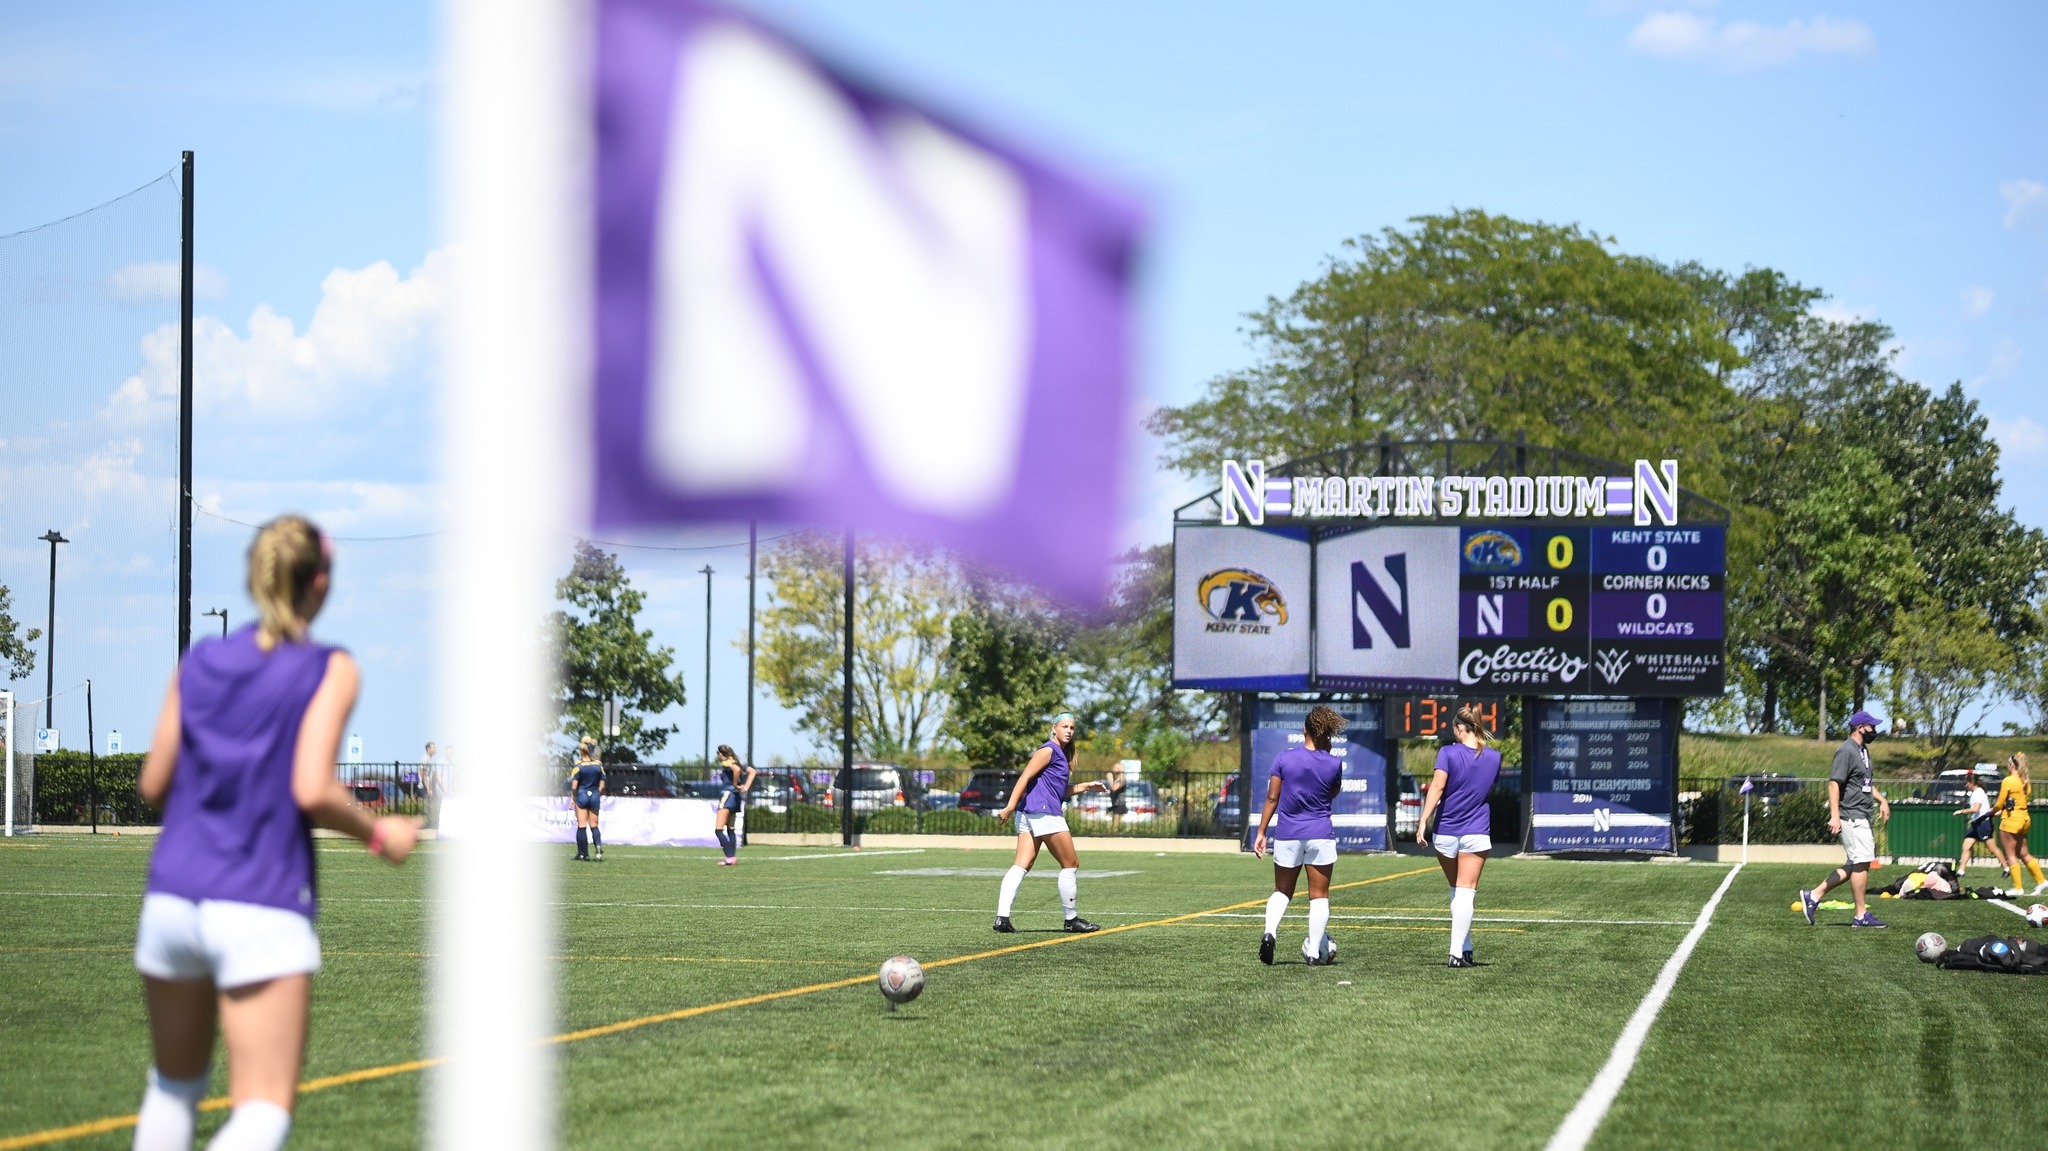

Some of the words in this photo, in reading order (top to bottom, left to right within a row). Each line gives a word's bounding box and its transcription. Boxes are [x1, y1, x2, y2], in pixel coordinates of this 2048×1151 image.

[642, 14, 1034, 514] N
[1221, 459, 1265, 526] N
[1291, 476, 1435, 517] MARTIN
[1440, 475, 1607, 517] STADIUM
[1634, 459, 1678, 526] N
[1611, 531, 1652, 544] KENT
[1654, 530, 1701, 544] STATE
[1547, 534, 1574, 570] 0
[1646, 545, 1668, 572] 0
[1489, 575, 1515, 590] 1ST
[1518, 575, 1560, 590] HALF
[1603, 574, 1664, 591] CORNER
[1666, 574, 1711, 591] KICKS
[1350, 552, 1411, 650] N
[1645, 592, 1668, 620] 0
[1477, 594, 1504, 636] N
[1546, 597, 1574, 632] 0
[1205, 622, 1237, 634] KENT
[1240, 624, 1272, 635] STATE
[1617, 621, 1695, 636] WILDCATS
[1459, 644, 1589, 685] Colectivo
[1634, 653, 1720, 666] WHITEHALL
[1491, 671, 1550, 684] COFFEE
[1403, 698, 1497, 735] 13:4
[1564, 701, 1596, 713] MEN'S
[1597, 701, 1636, 713] SOCCER
[1560, 720, 1609, 729] TOURNAMENT
[1610, 719, 1661, 729] APPEARANCES
[1626, 732, 1650, 742] 2007
[1629, 747, 1648, 757] 2011
[1552, 779, 1569, 791] BIG
[1570, 779, 1592, 791] TEN
[1592, 779, 1652, 791] CHAMPIONS
[1609, 793, 1631, 802] 2012
[1593, 808, 1610, 832] N
